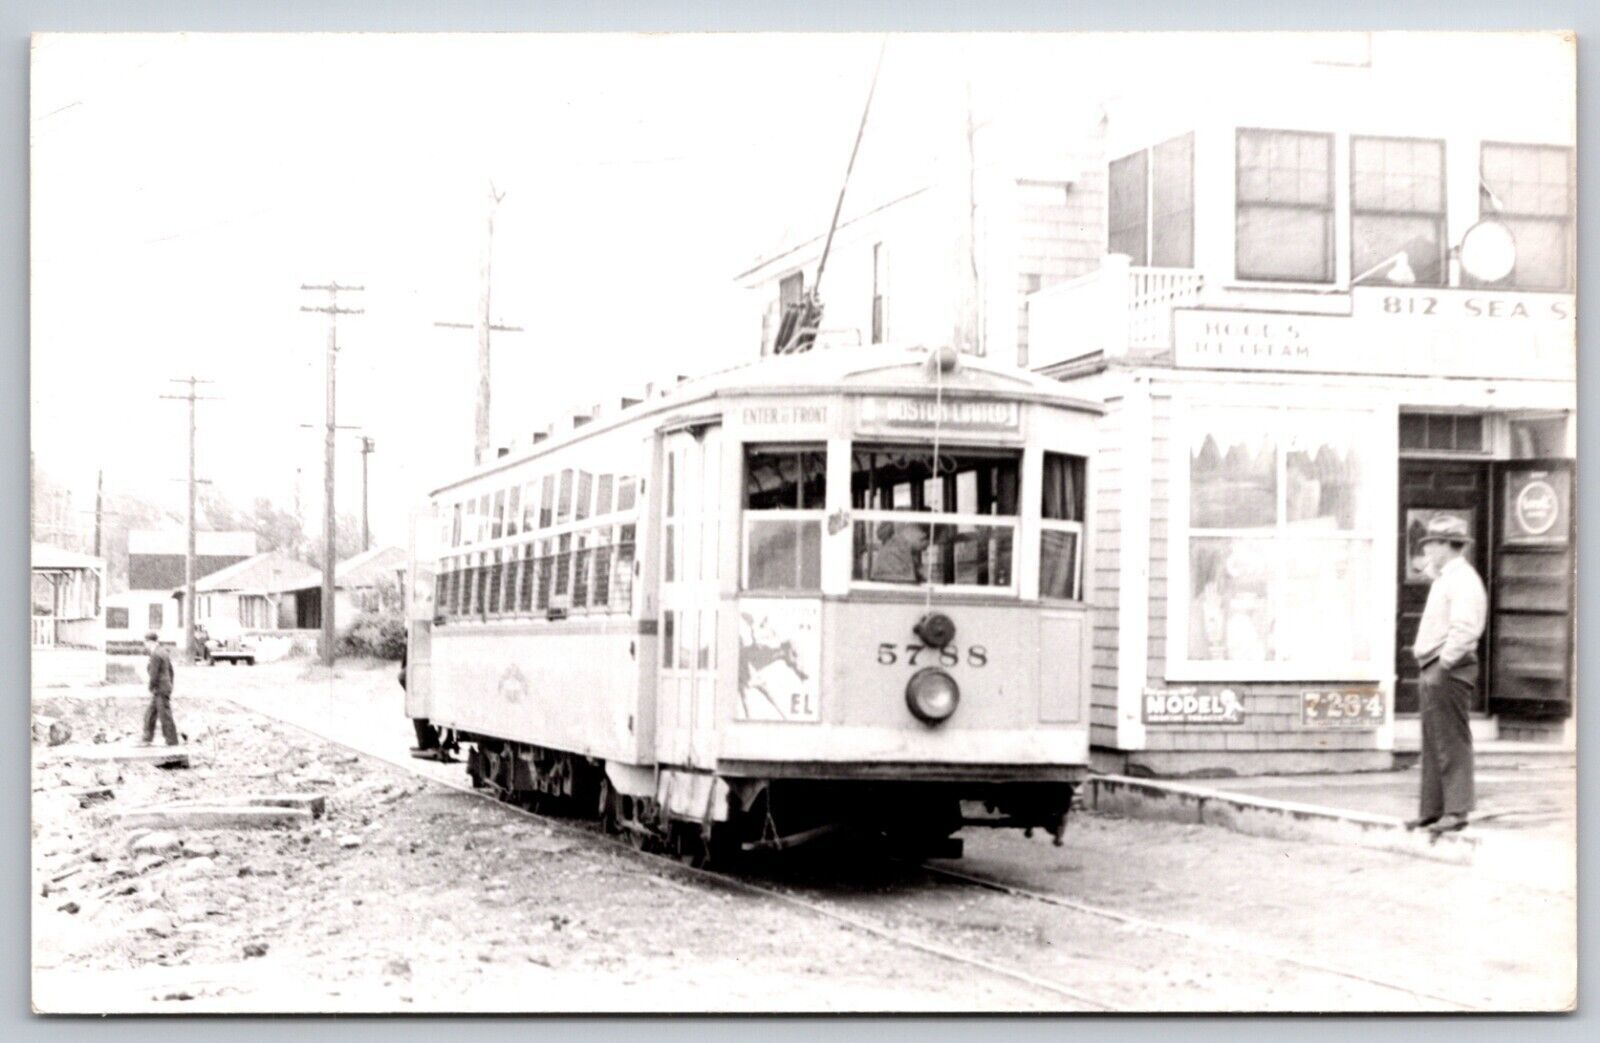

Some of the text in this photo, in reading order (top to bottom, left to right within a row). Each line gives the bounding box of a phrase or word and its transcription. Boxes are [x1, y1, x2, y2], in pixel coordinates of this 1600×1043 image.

[1382, 296, 1438, 316] 812
[1463, 297, 1530, 319] SEA
[743, 406, 778, 425] ENTER
[793, 405, 829, 424] FRONT
[877, 642, 988, 668] 5788
[789, 693, 815, 715] EL
[1146, 694, 1223, 715] MODEL
